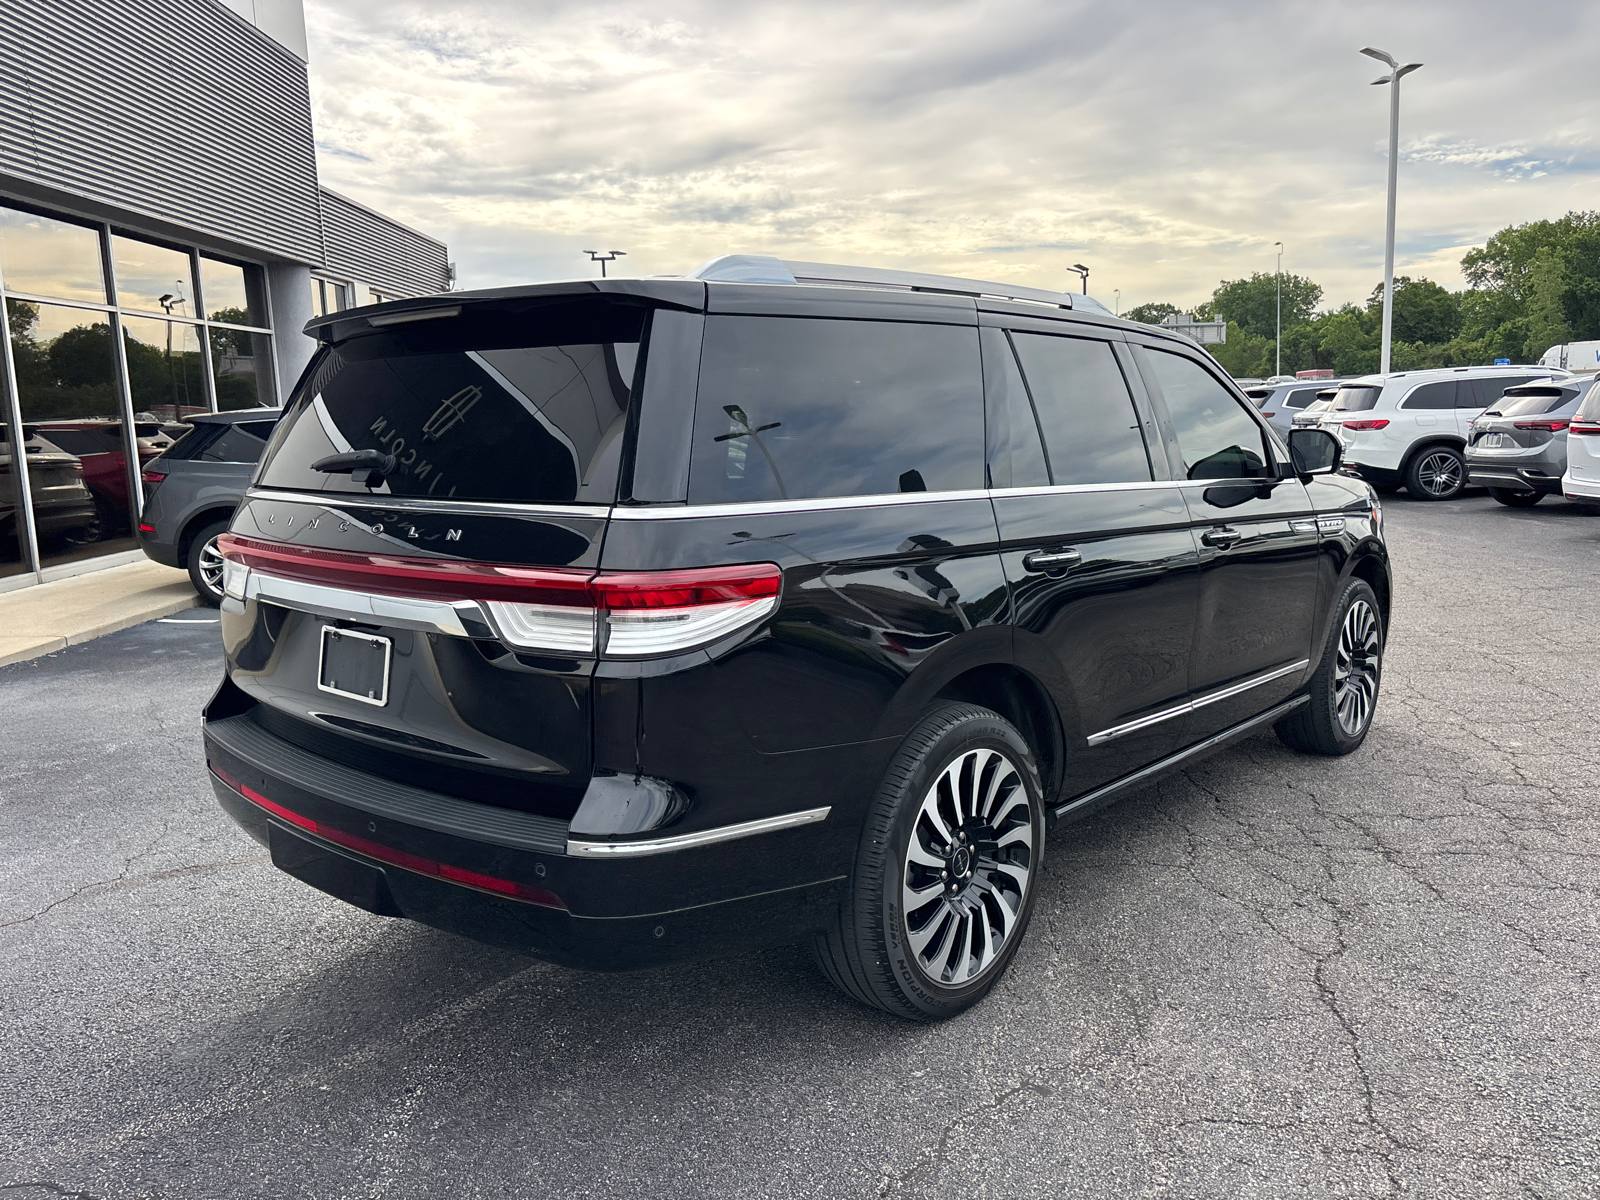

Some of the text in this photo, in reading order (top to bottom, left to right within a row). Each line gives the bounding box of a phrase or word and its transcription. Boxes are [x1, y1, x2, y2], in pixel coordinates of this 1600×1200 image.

[268, 514, 462, 541] LINCOLN
[989, 727, 1007, 738] R22
[888, 902, 950, 1007] SCORPION VERDE
